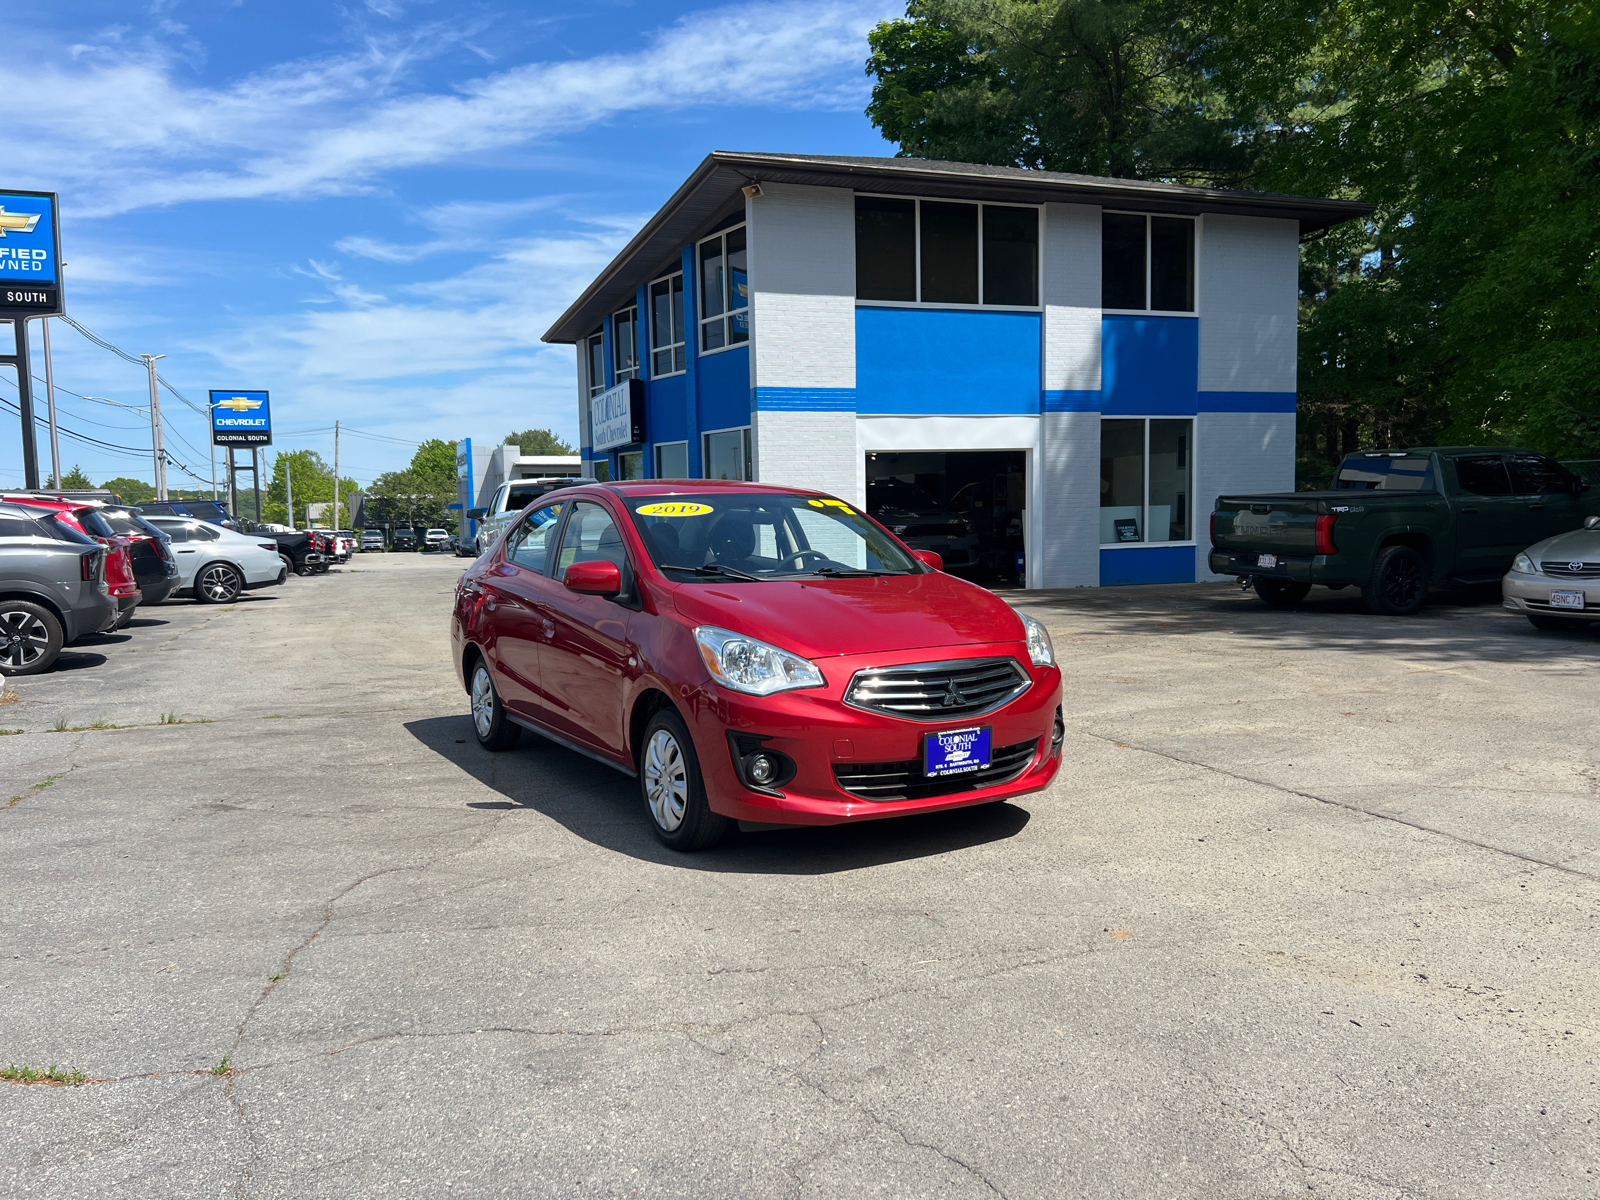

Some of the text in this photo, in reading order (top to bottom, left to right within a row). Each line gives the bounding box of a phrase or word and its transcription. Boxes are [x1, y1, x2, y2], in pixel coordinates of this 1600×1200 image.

[7, 291, 47, 303] SOUTH
[594, 388, 627, 427] COLONIAL
[652, 505, 700, 514] 2019
[1551, 594, 1570, 604] 4BNC
[939, 734, 977, 745] COLONIAL
[945, 742, 971, 752] SOUTH
